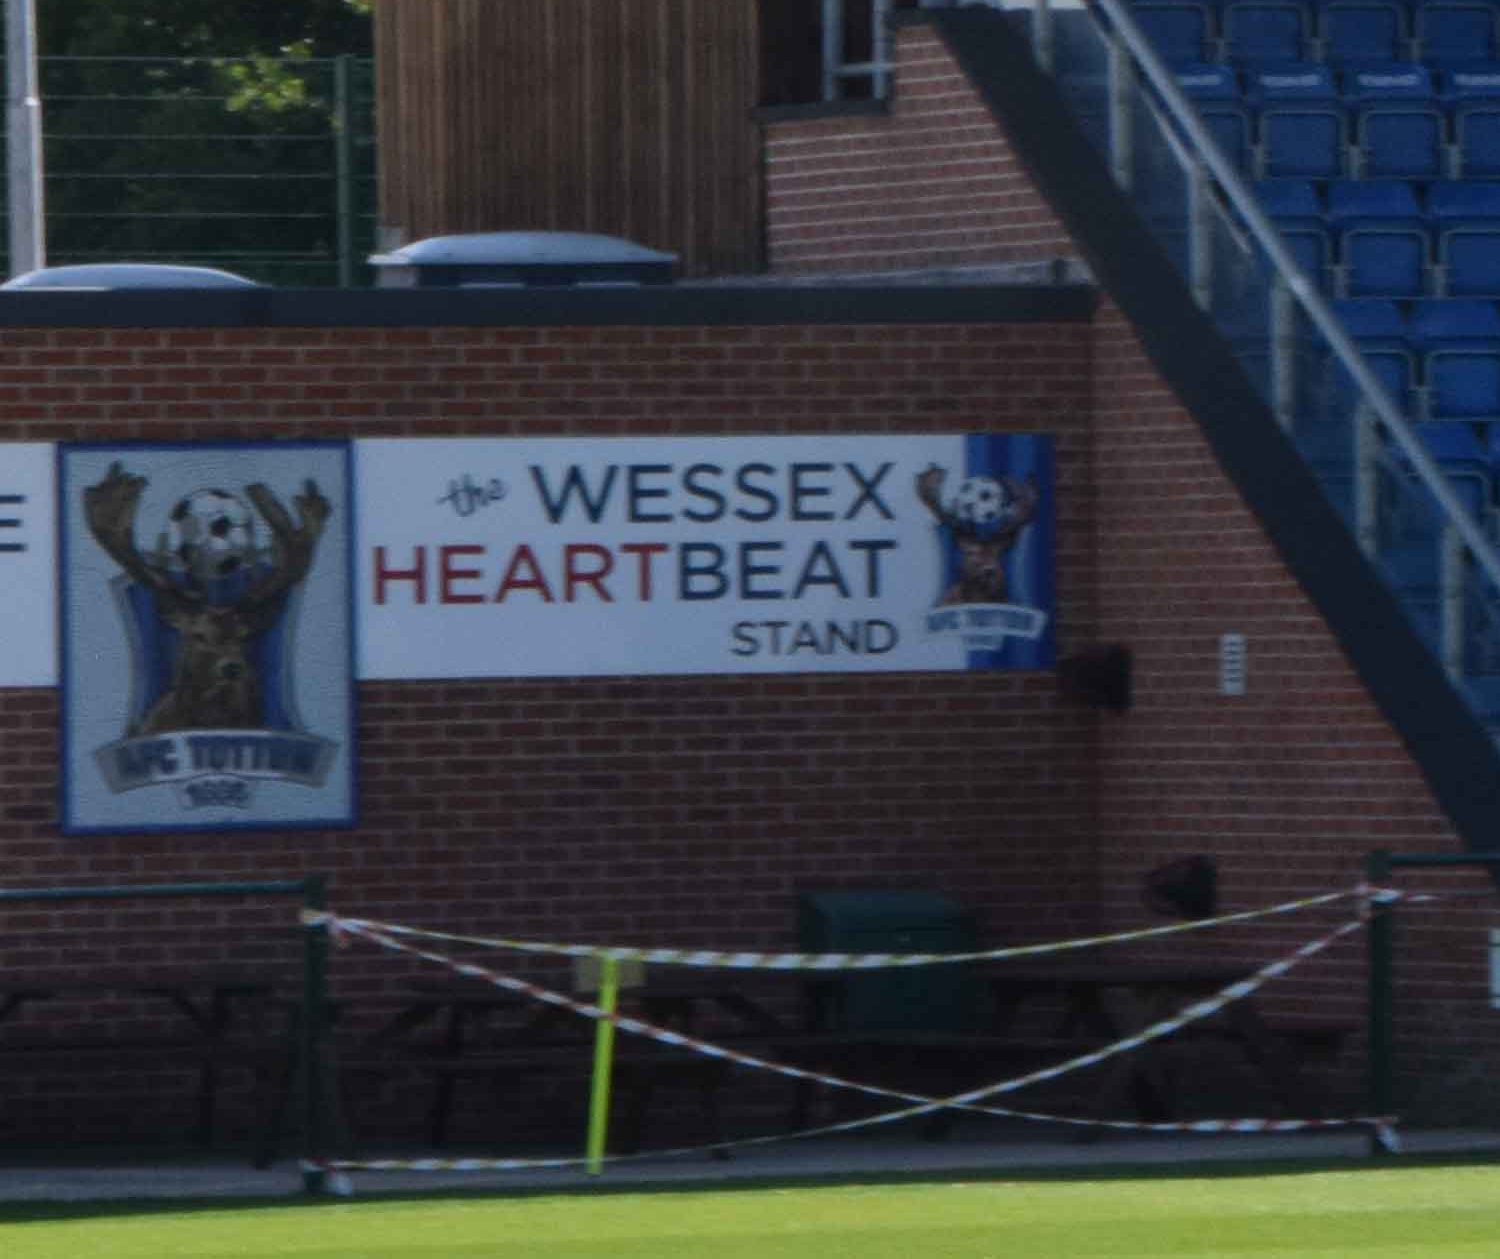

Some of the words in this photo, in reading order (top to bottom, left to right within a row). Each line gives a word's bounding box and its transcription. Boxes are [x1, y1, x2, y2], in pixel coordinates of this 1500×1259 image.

[437, 473, 506, 518] the
[529, 461, 897, 525] WESSEX
[372, 540, 898, 606] HEARTBEAT
[729, 618, 899, 656] STAND
